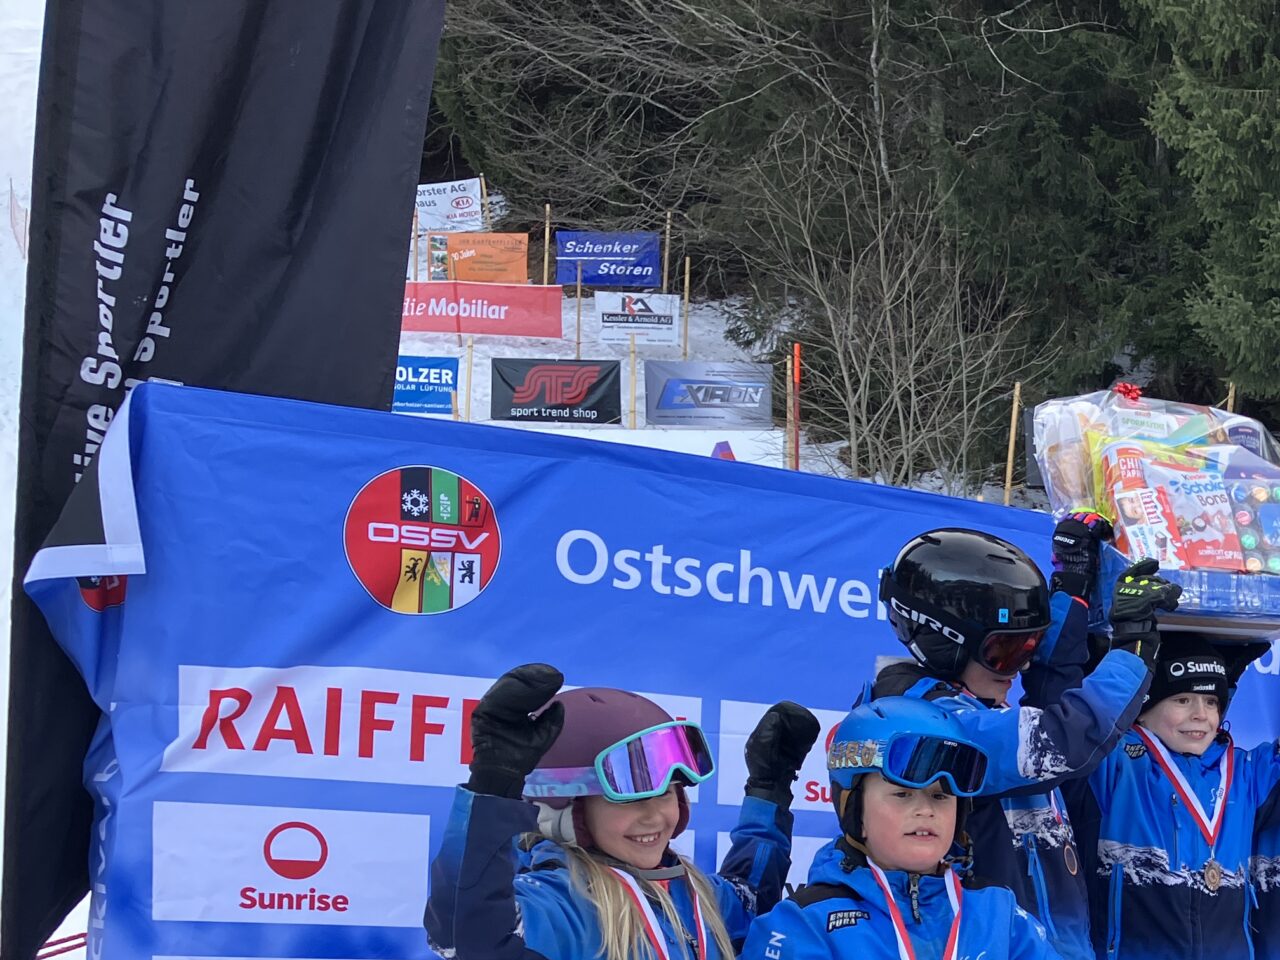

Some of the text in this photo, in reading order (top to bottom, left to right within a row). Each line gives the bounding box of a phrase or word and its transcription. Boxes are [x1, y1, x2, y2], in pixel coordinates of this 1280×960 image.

[450, 183, 467, 193] AG
[565, 241, 639, 254] Schenker
[598, 262, 653, 276] Storen
[428, 298, 509, 320] Mobiliar
[510, 406, 598, 420] sport trend shop
[1196, 493, 1228, 507] Bons
[367, 522, 490, 551] OSSV
[1119, 587, 1144, 595] LEKI
[890, 596, 965, 645] GIRO
[1187, 661, 1226, 676] Sunrise
[239, 887, 349, 912] Sunrise
